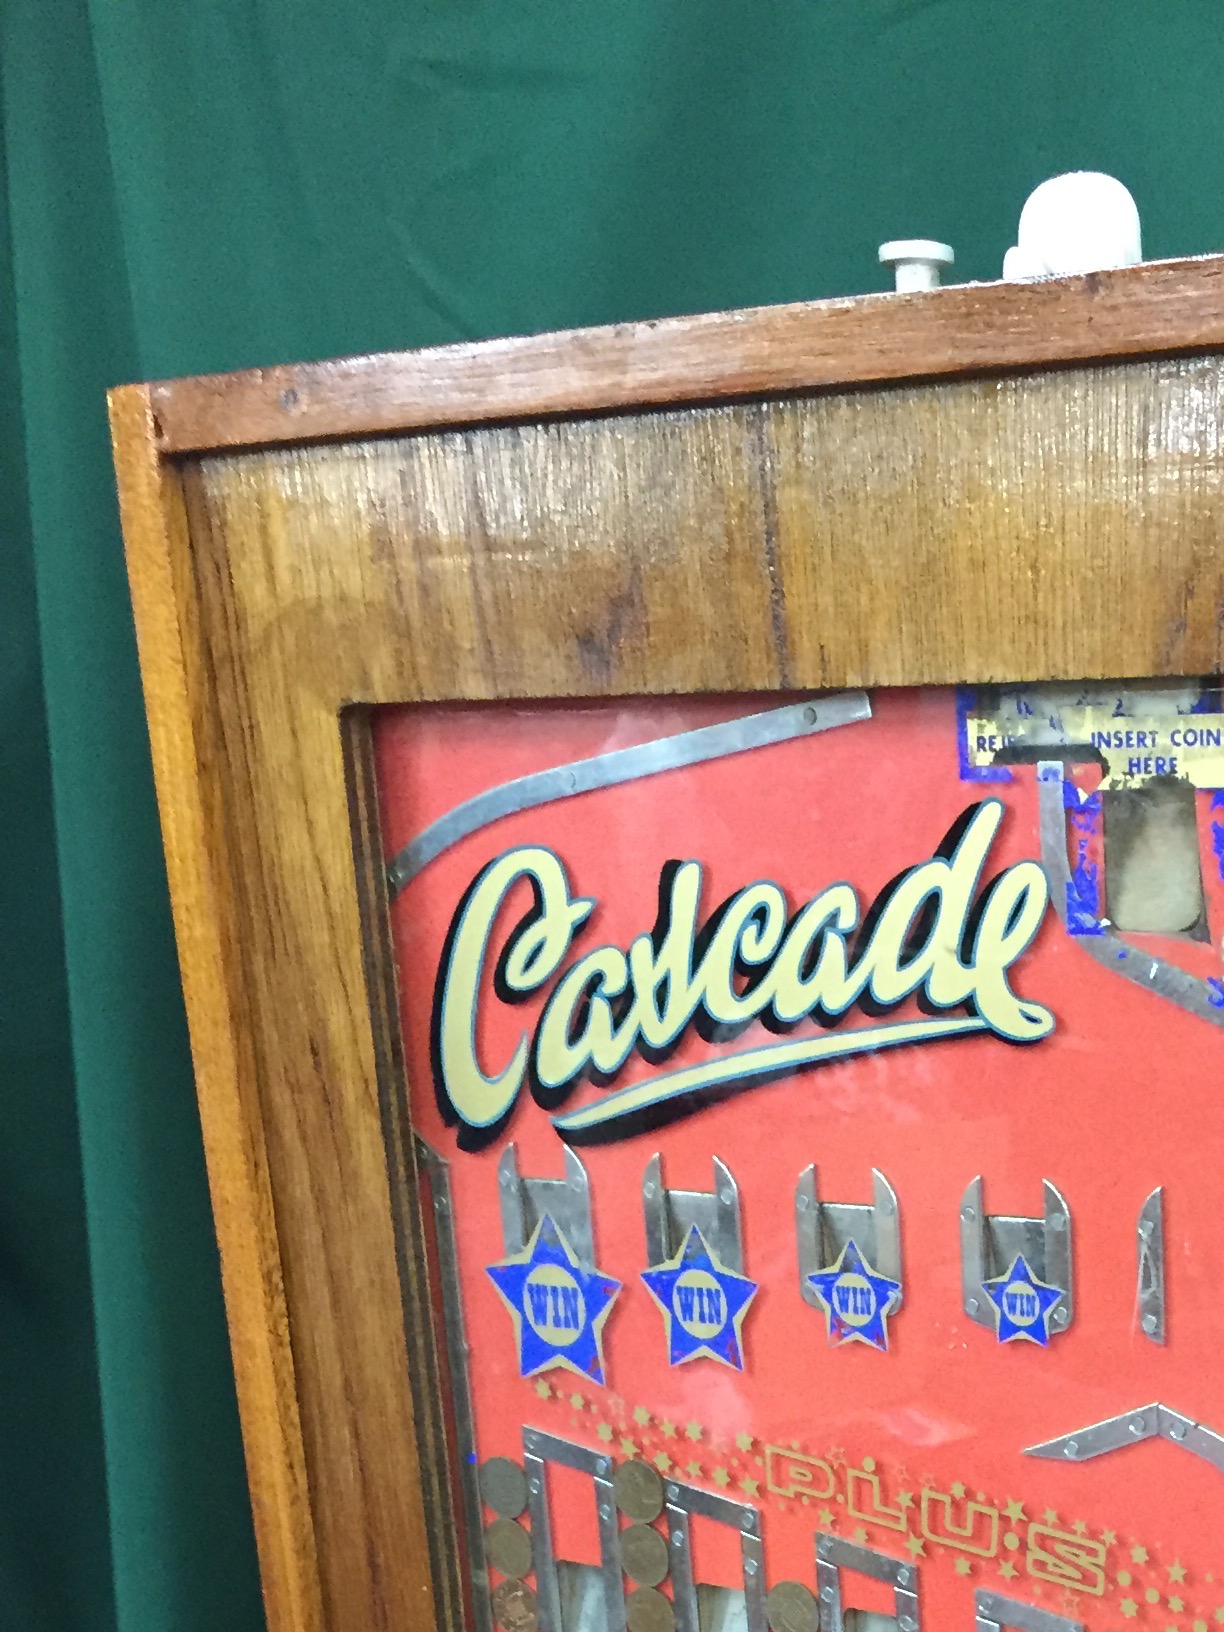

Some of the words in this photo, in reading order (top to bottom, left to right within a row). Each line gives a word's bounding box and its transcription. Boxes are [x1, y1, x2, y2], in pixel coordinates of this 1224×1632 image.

[1091, 729, 1157, 750] INSERT
[1170, 727, 1222, 747] COIN
[1128, 757, 1178, 776] HERE
[429, 797, 1056, 1154] Cascade
[526, 1283, 579, 1331] WIN
[680, 1287, 722, 1325] WIN
[834, 1286, 876, 1317] WIN
[1004, 1292, 1037, 1317] WIN
[765, 1444, 1106, 1596] PLUS
